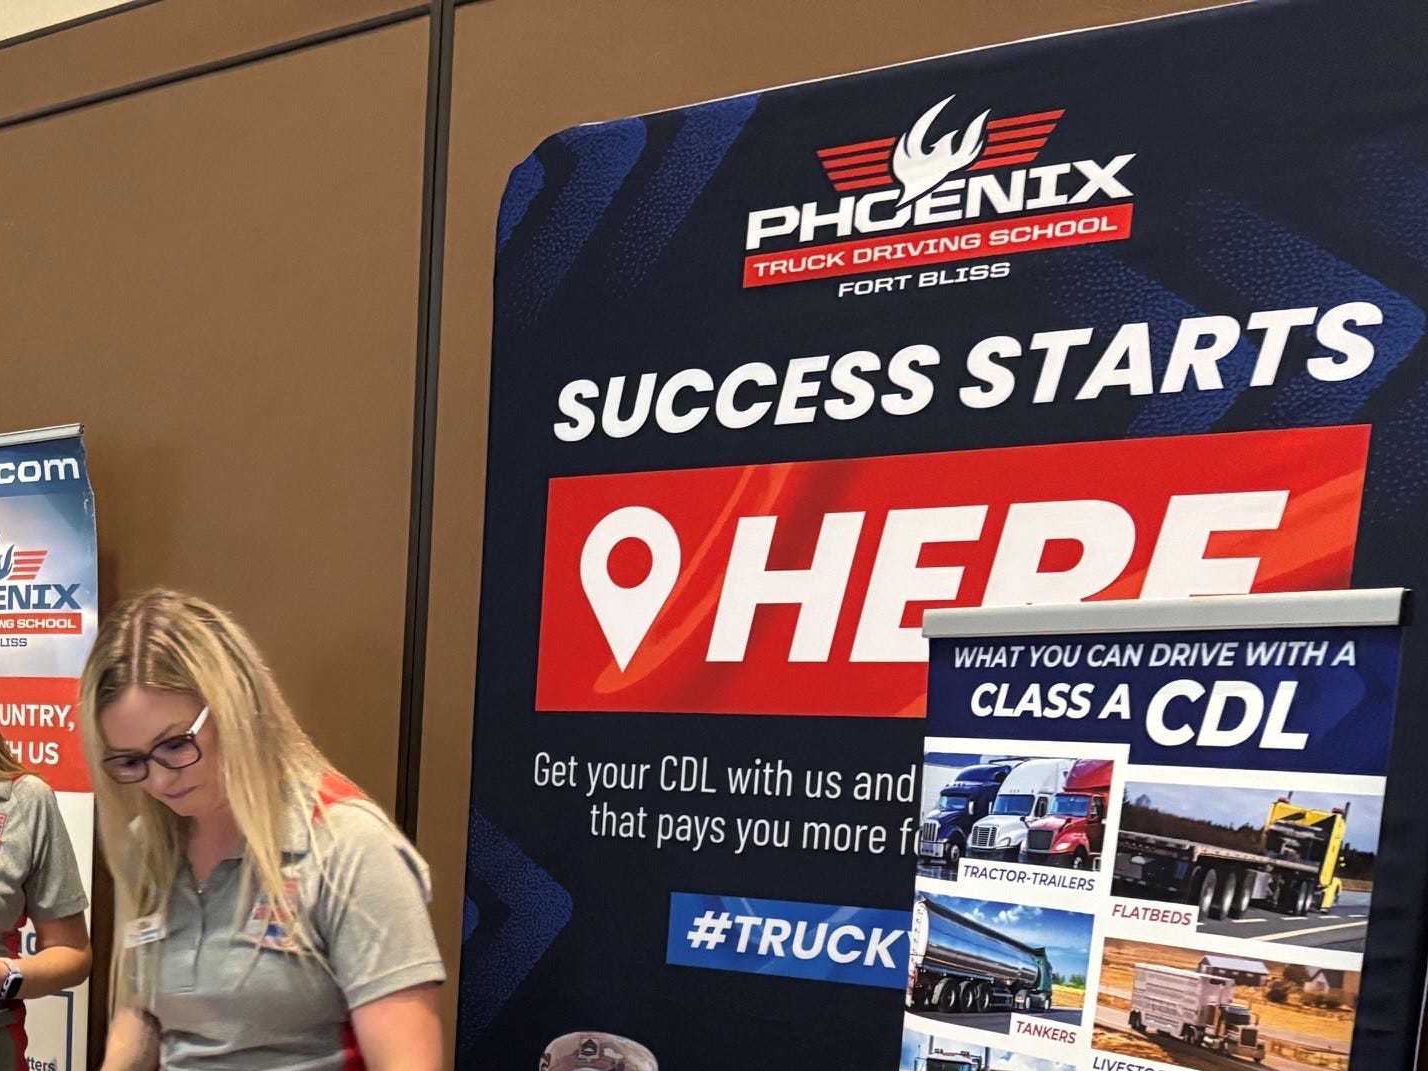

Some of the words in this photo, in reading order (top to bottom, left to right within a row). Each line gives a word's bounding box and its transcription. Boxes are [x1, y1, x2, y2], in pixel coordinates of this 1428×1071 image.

[746, 154, 1137, 250] PHOENIX
[753, 250, 846, 278] TRUCK
[853, 232, 982, 265] DRIVING
[988, 216, 1118, 247] SCHOOL
[838, 275, 912, 298] FORT
[918, 262, 1011, 288] BLISS
[552, 343, 939, 443] SUCCESS
[958, 301, 1385, 404] STARTS
[17, 618, 77, 629] SCHOOL
[954, 645, 1023, 669] WHAT
[1029, 645, 1079, 668] YOU
[1087, 644, 1143, 668] CAN
[1148, 642, 1236, 667] DRIVE
[1246, 640, 1327, 667] WITH
[1330, 640, 1356, 666] A
[970, 682, 1092, 720] CLASS
[1099, 683, 1131, 720] A
[1145, 678, 1310, 750] CDL
[28, 741, 59, 765] US
[534, 752, 578, 788] Get
[586, 762, 650, 797] your
[660, 755, 717, 793] CDL
[727, 759, 792, 796] with
[805, 771, 842, 799] us
[854, 764, 915, 802] and
[590, 803, 646, 839] that
[657, 813, 725, 851] pays
[735, 820, 790, 854] you
[802, 822, 887, 855] more
[963, 864, 1095, 893] TRACTOR-TRAILERS
[1112, 904, 1192, 927] FLATBEDS
[687, 910, 913, 969] #TRUCK
[1016, 1021, 1077, 1045] TANKERS
